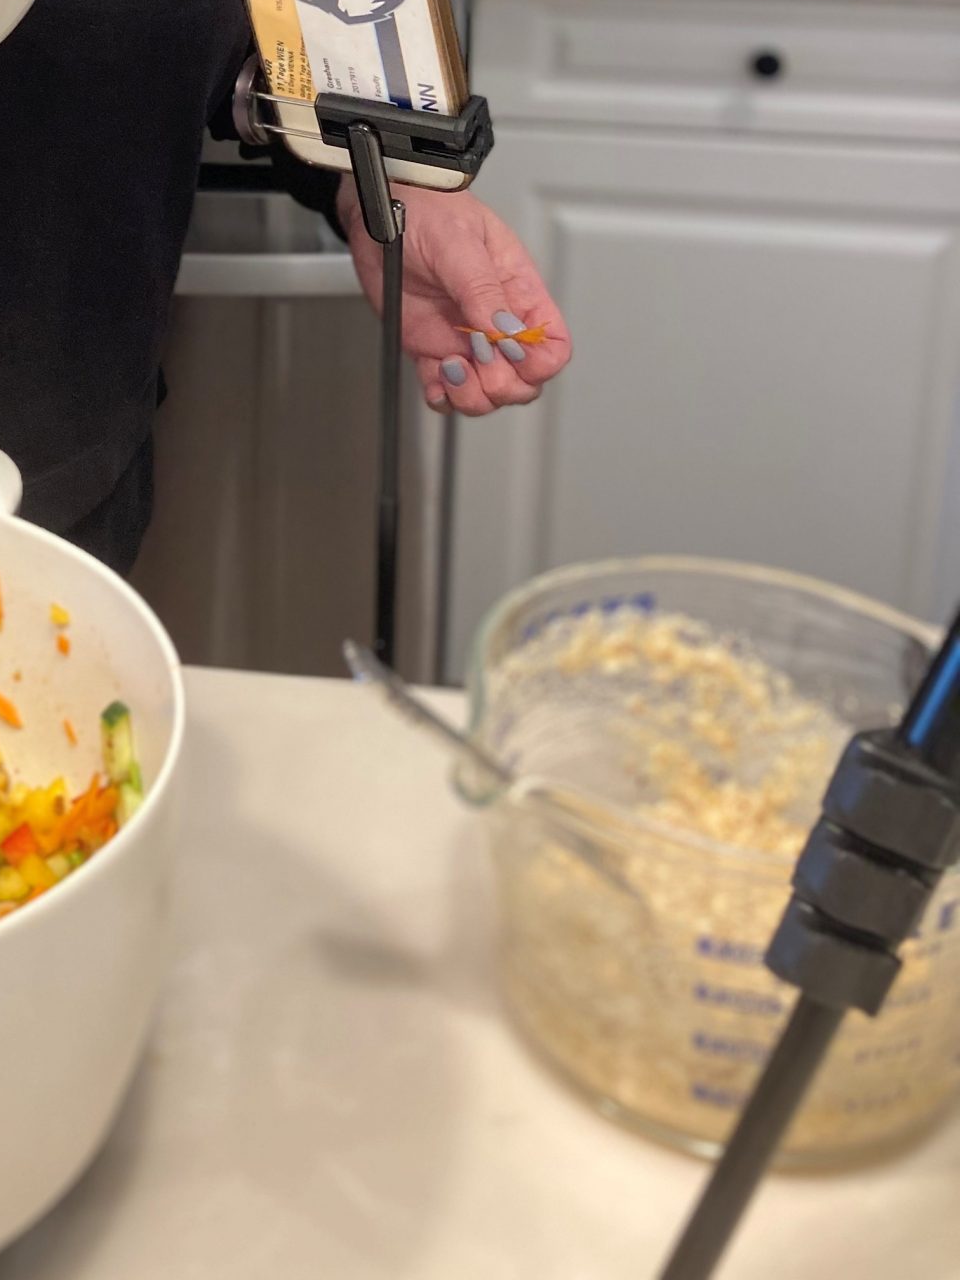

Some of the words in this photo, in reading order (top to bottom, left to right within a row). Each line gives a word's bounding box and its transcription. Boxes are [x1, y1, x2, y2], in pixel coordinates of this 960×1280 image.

[276, 40, 285, 61] WIEN
[276, 62, 287, 81] Tage
[287, 51, 295, 72] VIENNA
[323, 58, 334, 89] Gresham
[276, 82, 285, 92] 31
[373, 74, 382, 98] Faculty
